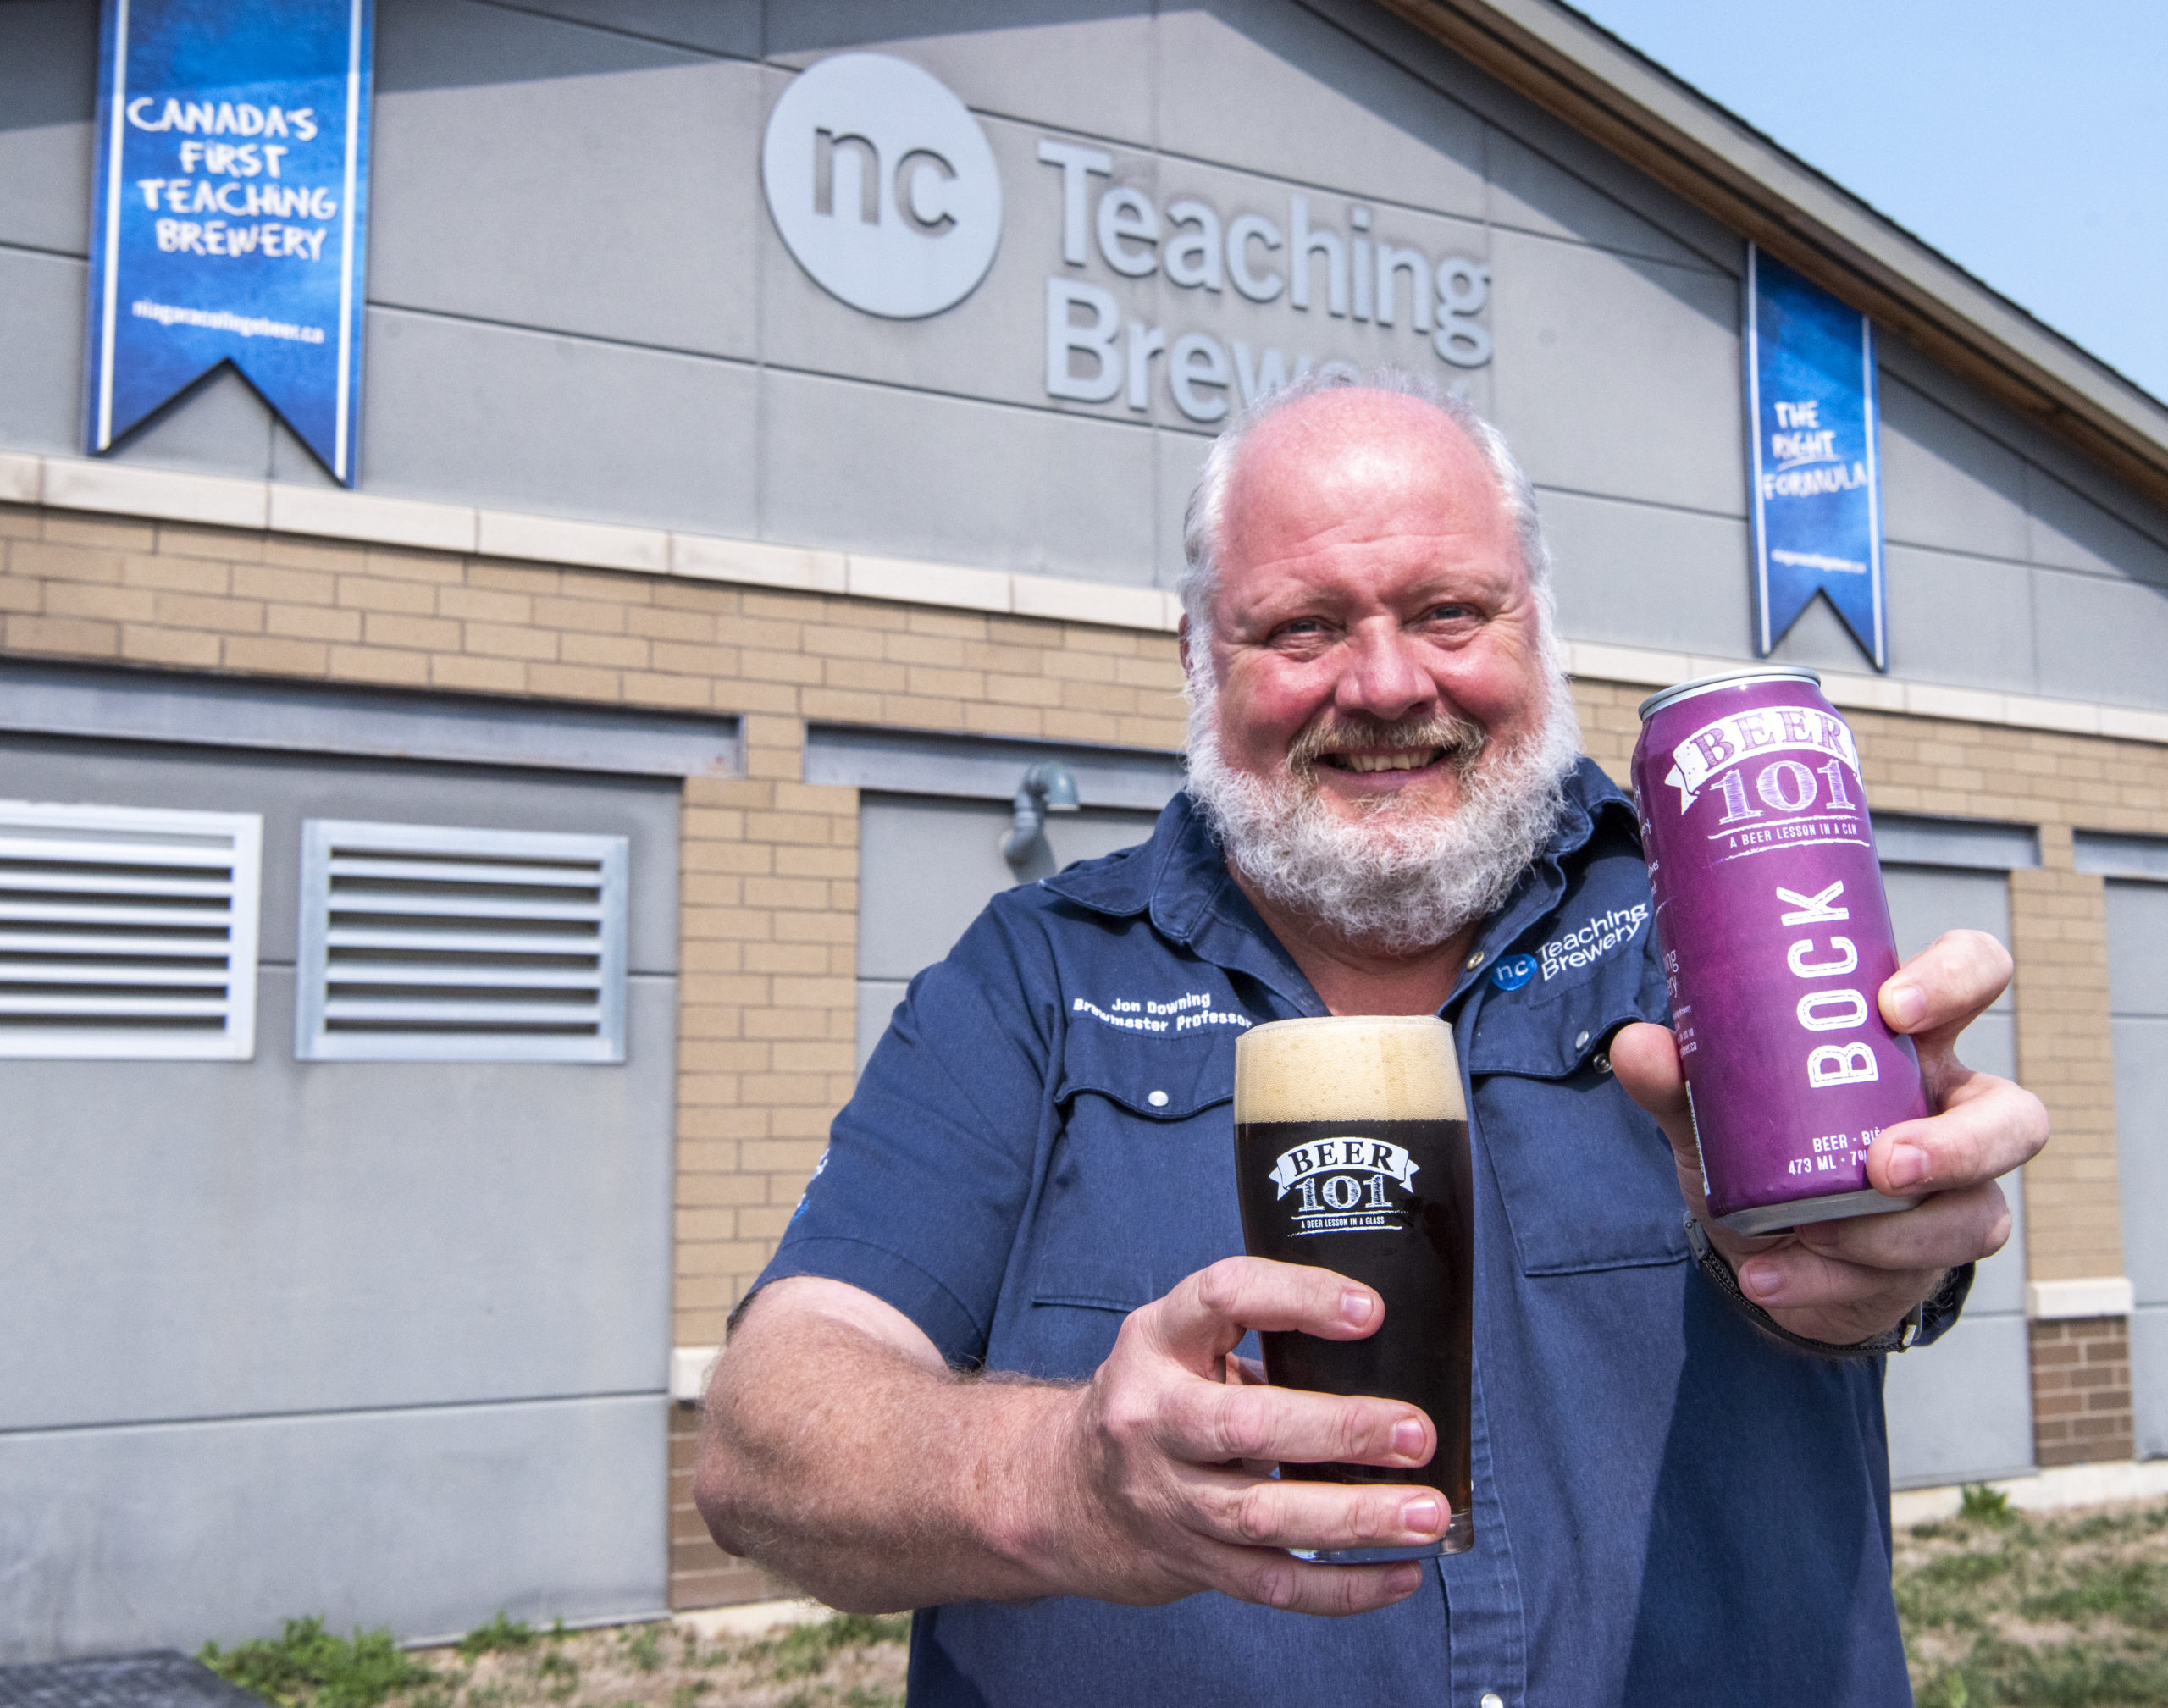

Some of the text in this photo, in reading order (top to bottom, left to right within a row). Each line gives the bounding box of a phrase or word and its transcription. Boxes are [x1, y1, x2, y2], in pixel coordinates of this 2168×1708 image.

[126, 96, 318, 141] CANADA'S
[180, 140, 288, 179] FIRST
[137, 178, 337, 220] TEACHING
[814, 126, 959, 238] nc
[155, 218, 326, 262] BREWERY
[1037, 139, 1493, 370] Teaching
[1045, 276, 1360, 423] Brew
[1774, 401, 1820, 429] THE
[1772, 430, 1835, 460] RIGHT
[1762, 462, 1868, 500] FORMULA
[1690, 710, 1848, 772] BEER
[1708, 759, 1856, 825] 101
[1730, 823, 1857, 848] A BEER LESSON IN A CAN
[1535, 903, 1649, 961] Teaching
[1540, 920, 1640, 982] Brewery
[1496, 960, 1529, 981] nc
[1776, 880, 1880, 1089] BOCK
[1072, 998, 1253, 1032] Brewmaster Professor
[1111, 992, 1211, 1015] Jon Downing
[1288, 1141, 1394, 1177] BEER
[1812, 1133, 1849, 1153] BEER
[1788, 1157, 1812, 1175] 473
[1816, 1153, 1837, 1171] ML
[1295, 1174, 1393, 1213] 101
[1301, 1216, 1385, 1230] A BEER LESSON IN A GLASS
